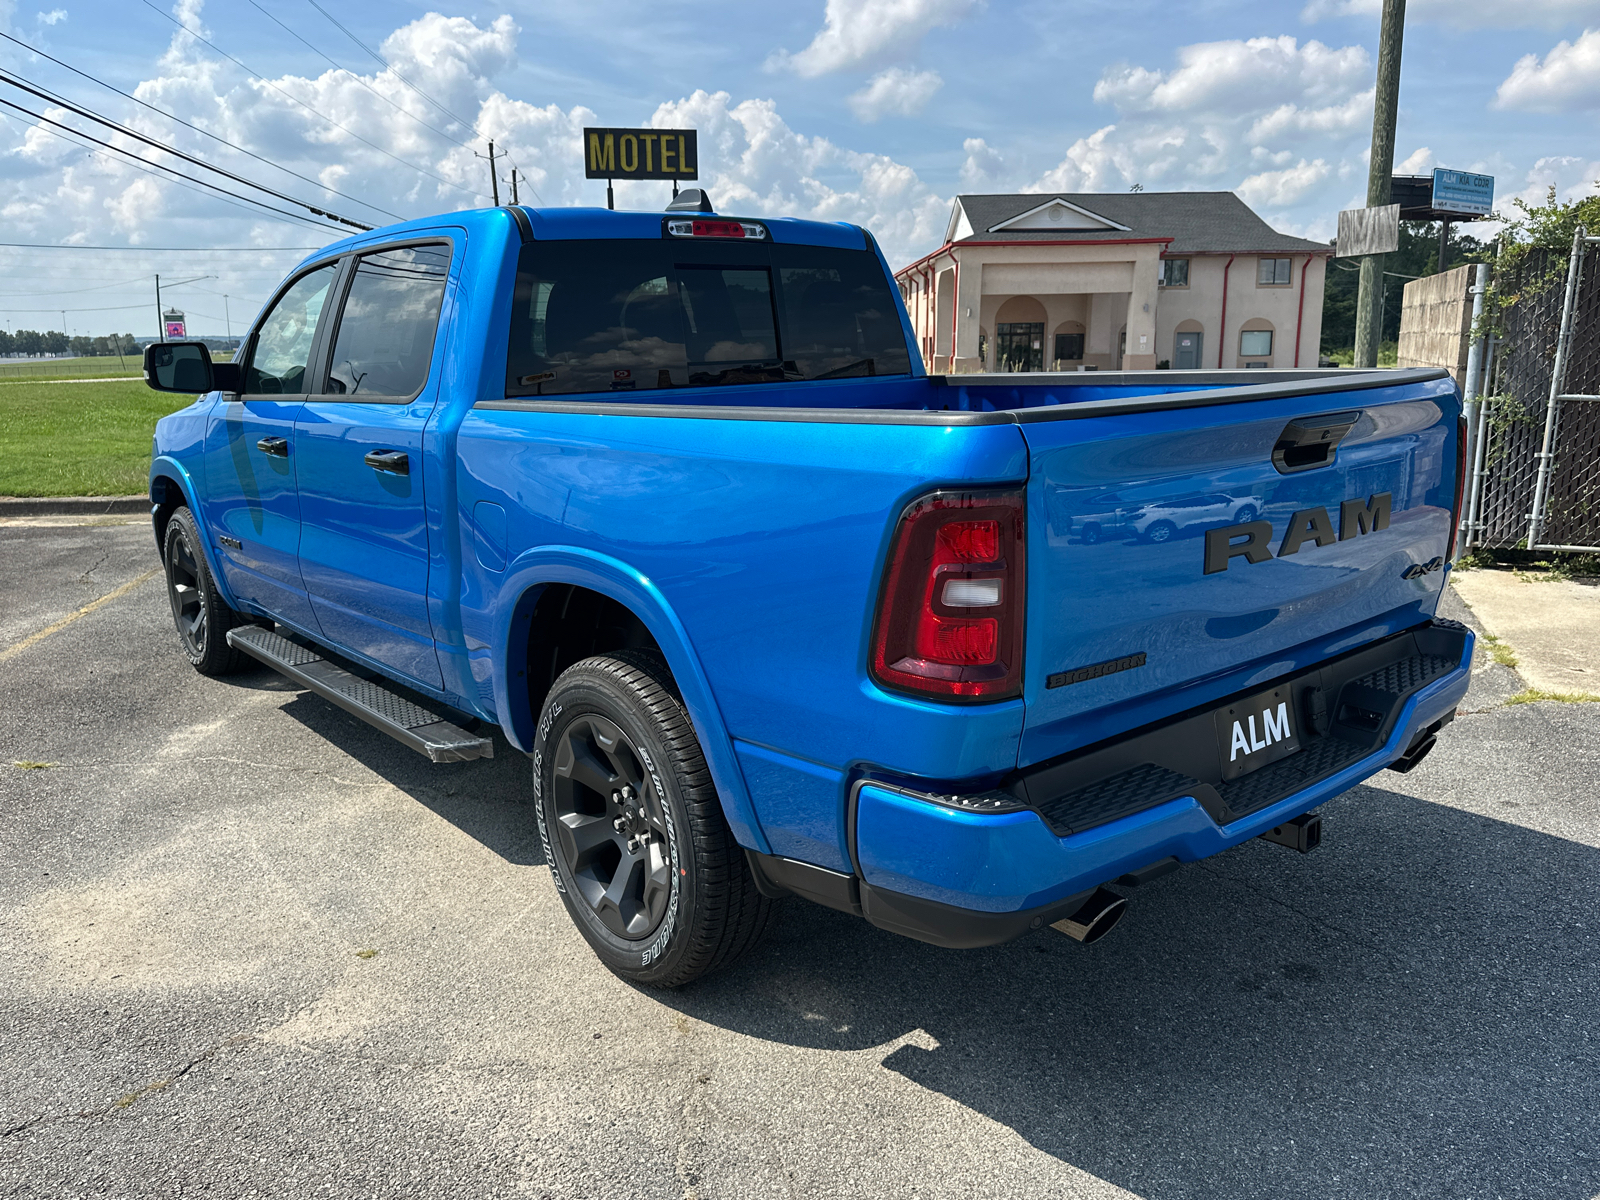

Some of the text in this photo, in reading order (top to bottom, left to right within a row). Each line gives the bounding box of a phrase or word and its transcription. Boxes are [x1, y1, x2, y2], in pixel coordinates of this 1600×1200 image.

[589, 133, 695, 172] MOTEL
[1442, 173, 1489, 188] ALM KIA CDJR
[1203, 490, 1392, 575] RAM
[1045, 651, 1147, 690] BIGHORN
[1230, 702, 1291, 762] ALM
[533, 701, 567, 893] DUELER H/L
